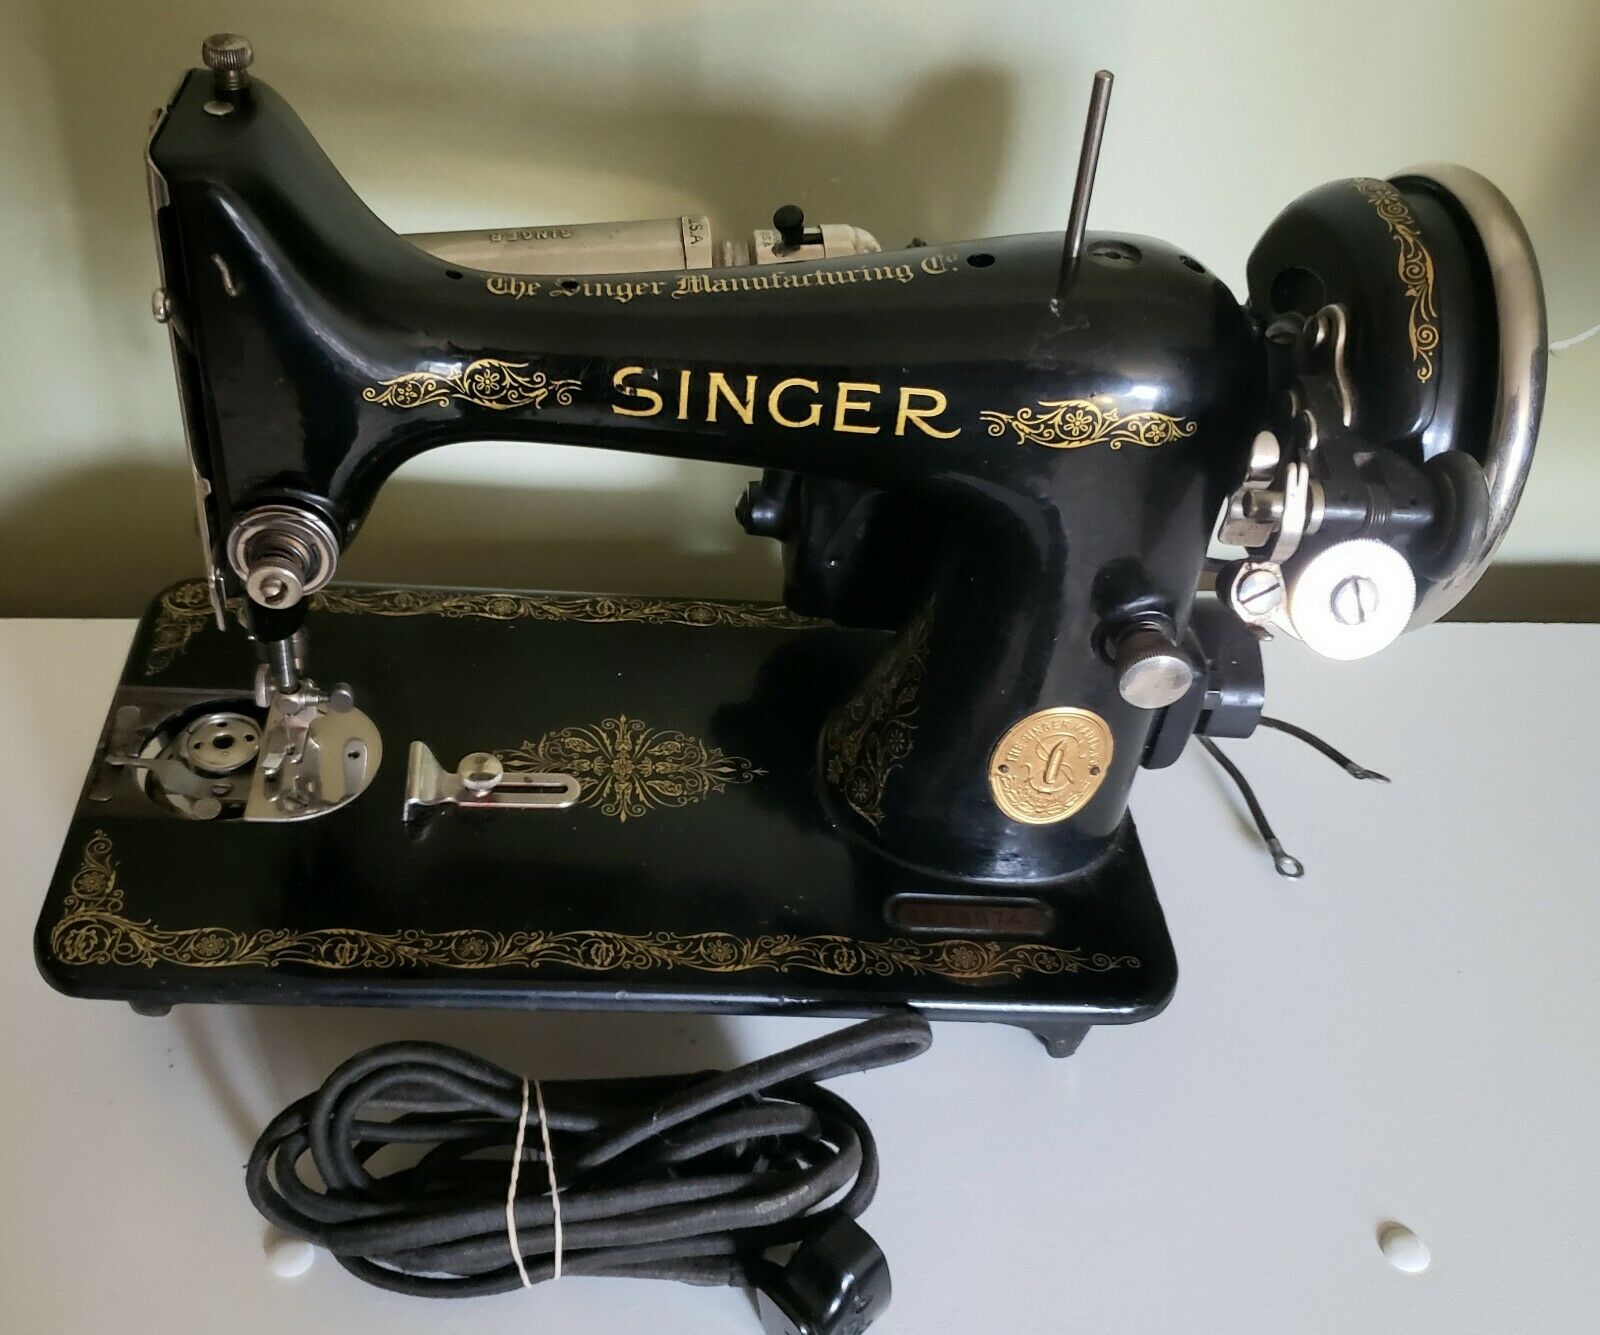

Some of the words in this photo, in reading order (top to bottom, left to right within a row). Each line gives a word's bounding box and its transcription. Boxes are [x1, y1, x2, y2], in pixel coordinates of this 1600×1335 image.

[486, 276, 541, 300] The
[549, 276, 666, 303] Singer
[671, 264, 914, 300] Manufacturing
[612, 366, 961, 439] SINGER
